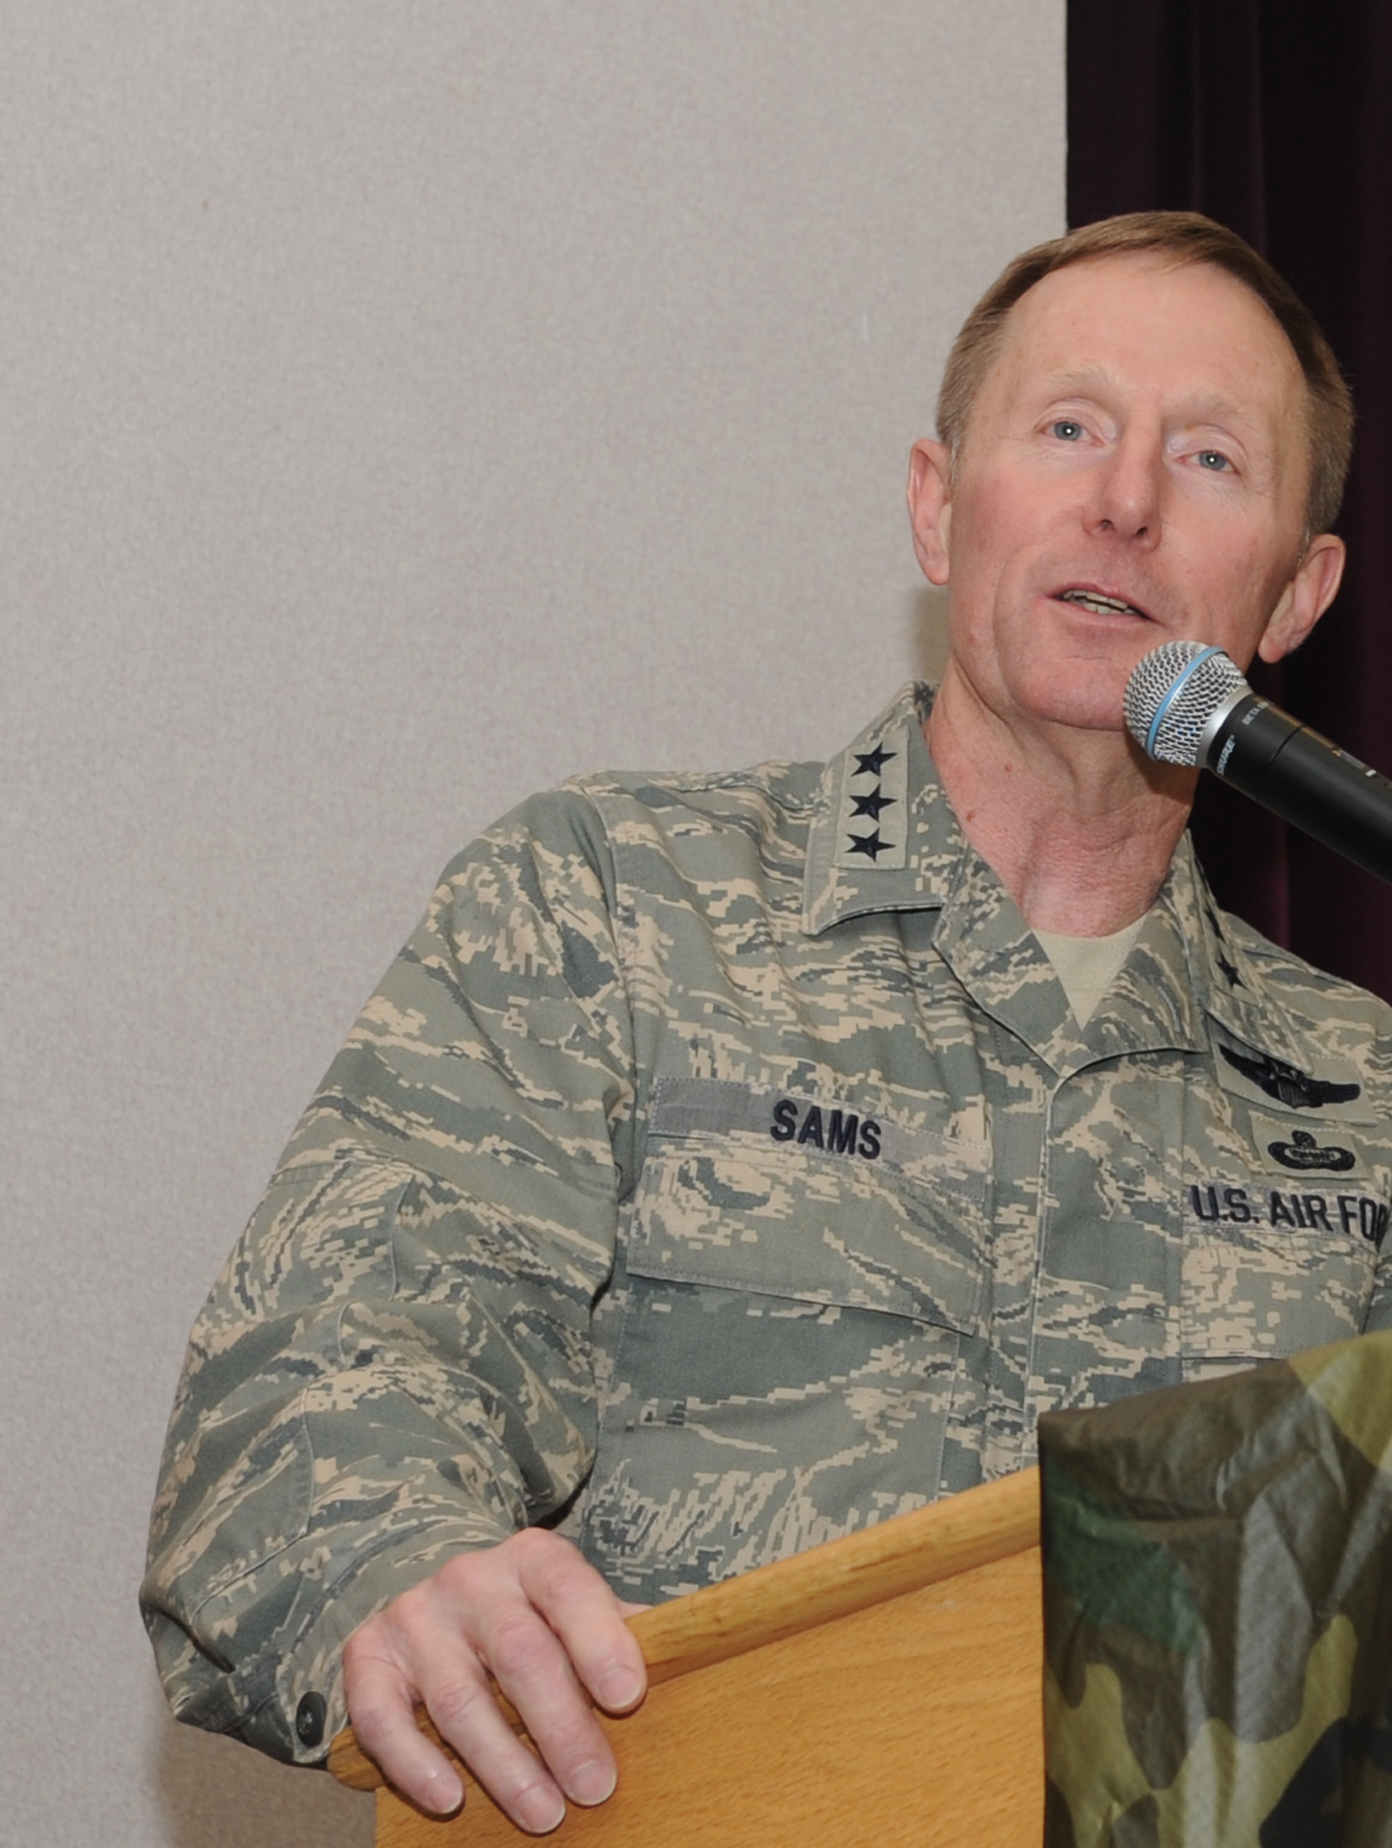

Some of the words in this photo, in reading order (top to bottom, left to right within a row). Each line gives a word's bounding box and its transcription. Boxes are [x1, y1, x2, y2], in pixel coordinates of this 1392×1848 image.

[1216, 737, 1236, 776] SHURE
[770, 1099, 882, 1160] SAMS
[1190, 1184, 1260, 1224] U.S.
[1270, 1190, 1334, 1231] AIR
